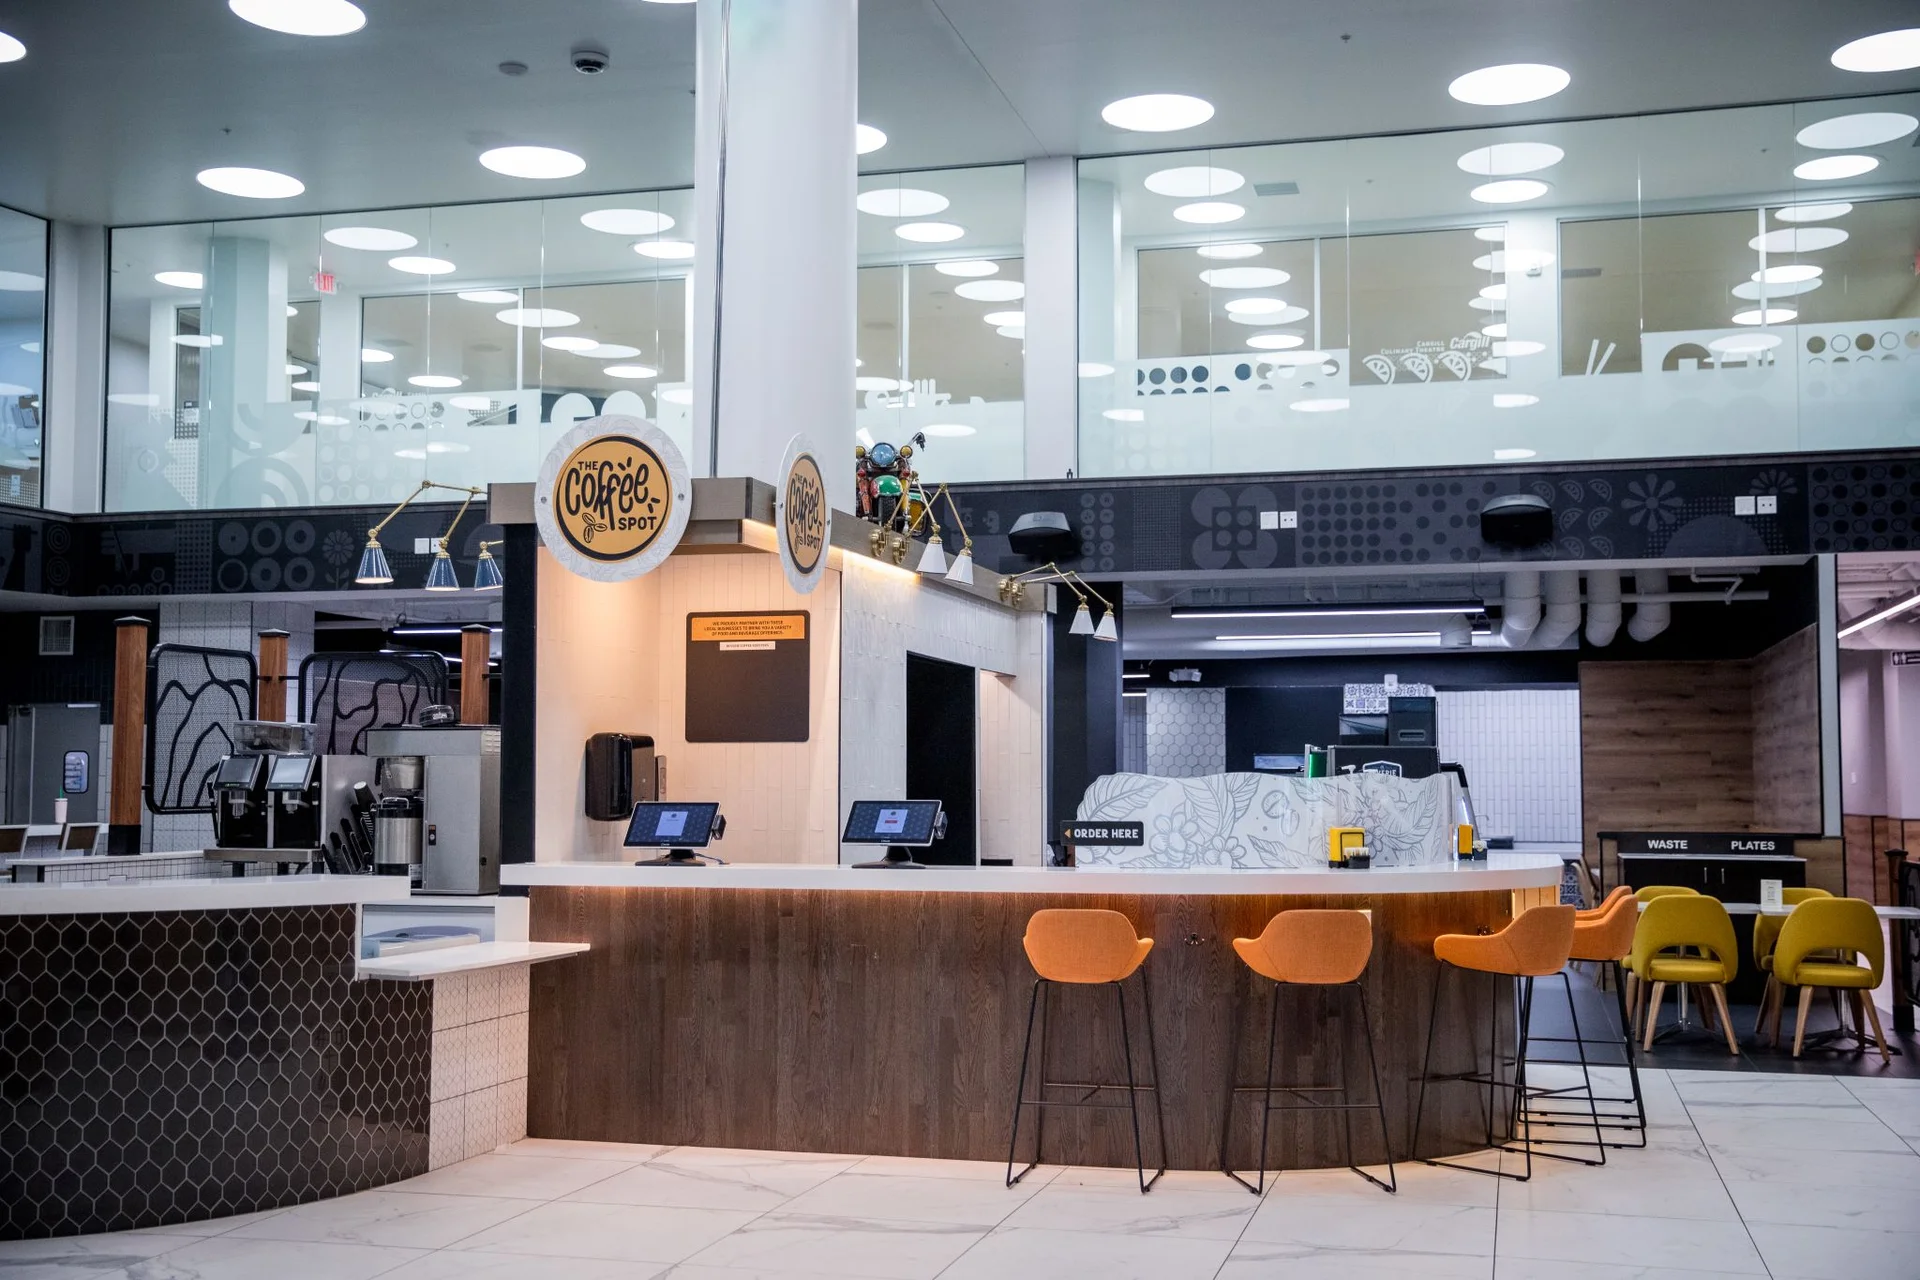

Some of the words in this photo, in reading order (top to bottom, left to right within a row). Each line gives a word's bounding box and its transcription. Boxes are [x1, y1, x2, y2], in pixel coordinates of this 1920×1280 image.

[1449, 335, 1490, 351] Cargill
[577, 460, 599, 471] THE
[794, 472, 803, 484] THE
[564, 460, 650, 531] Coffee
[788, 477, 819, 546] Coffee
[618, 516, 658, 531] SPOT
[806, 533, 821, 550] SPOT
[1074, 828, 1109, 839] ORDER
[1111, 828, 1139, 839] HERE
[1647, 839, 1688, 850] WASTE
[1730, 840, 1776, 851] PLATES
